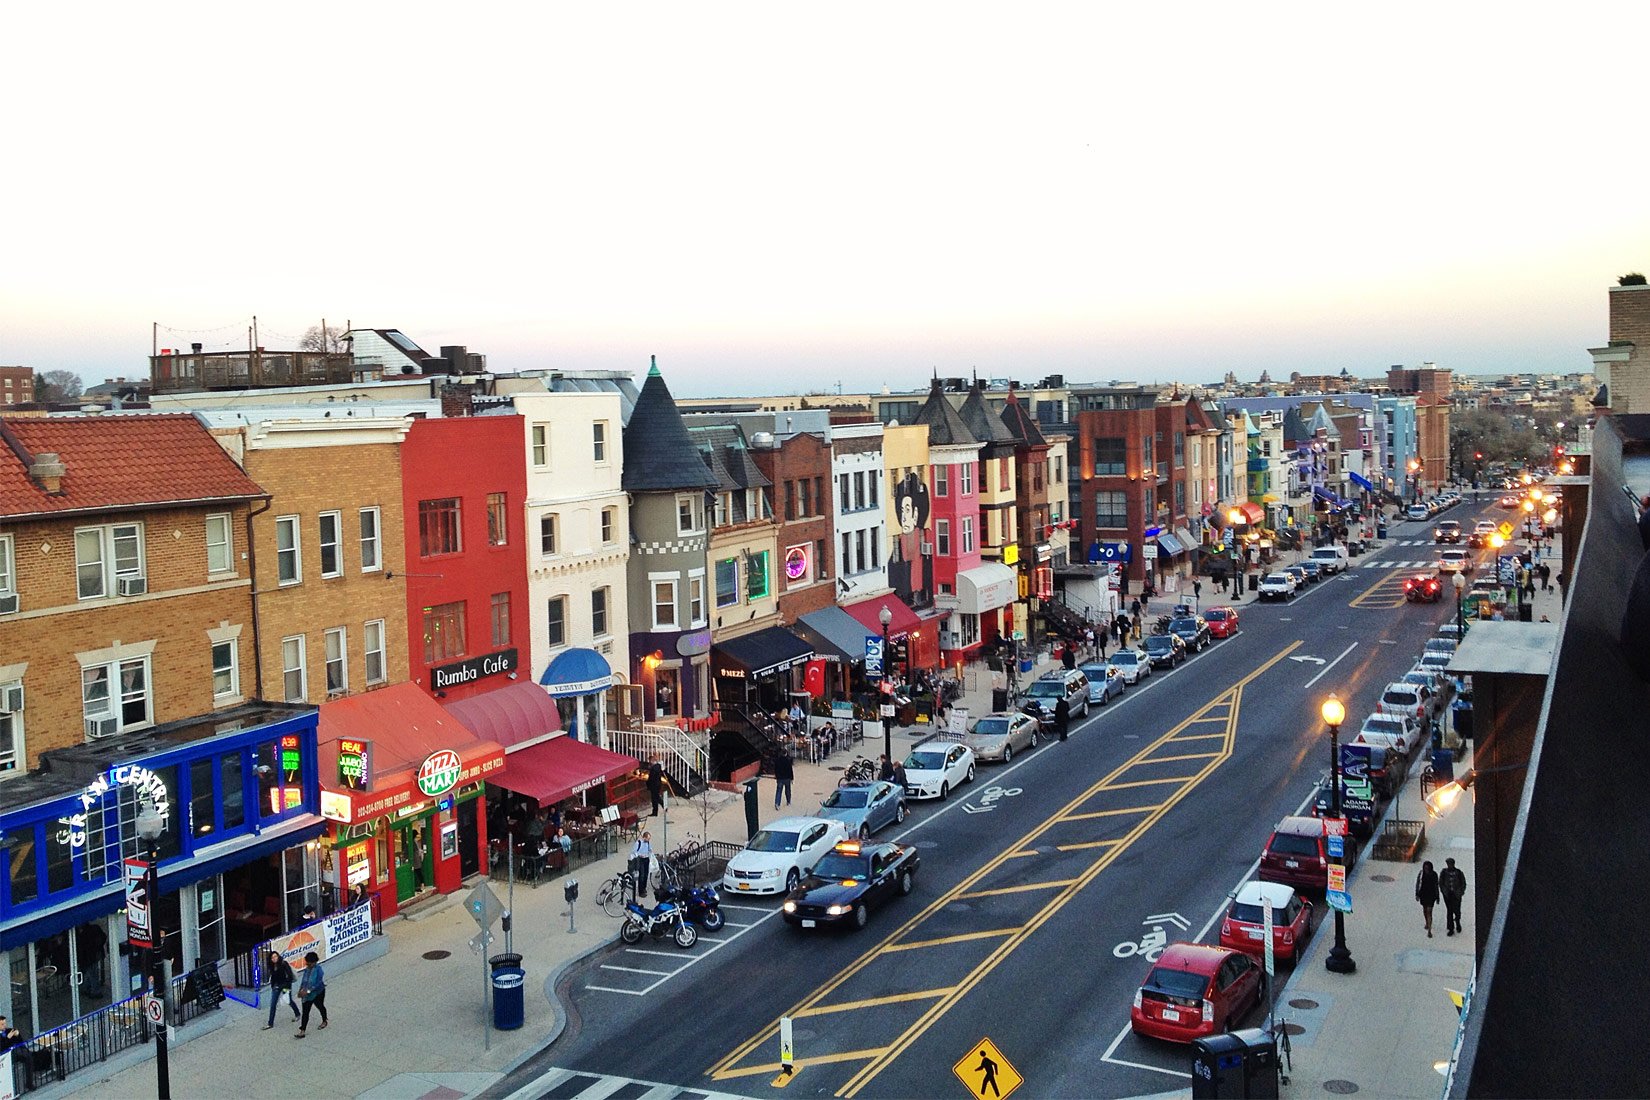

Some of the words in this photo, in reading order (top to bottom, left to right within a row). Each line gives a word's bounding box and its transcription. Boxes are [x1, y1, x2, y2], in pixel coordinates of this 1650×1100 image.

[437, 665, 477, 687] Rumba
[483, 655, 509, 675] Cafe
[342, 742, 362, 753] REAL
[340, 755, 361, 767] JUMBO
[424, 753, 458, 776] PIZZA
[424, 768, 459, 793] MART
[572, 780, 592, 794] RUMBA
[592, 774, 606, 787] CAFE
[1345, 750, 1368, 798] PLAY
[127, 865, 149, 929] EAT
[327, 916, 345, 928] JOIN
[356, 904, 369, 916] FOR
[334, 915, 363, 935] MARCH
[330, 921, 370, 945] MADNESS
[298, 940, 320, 954] LIGHT
